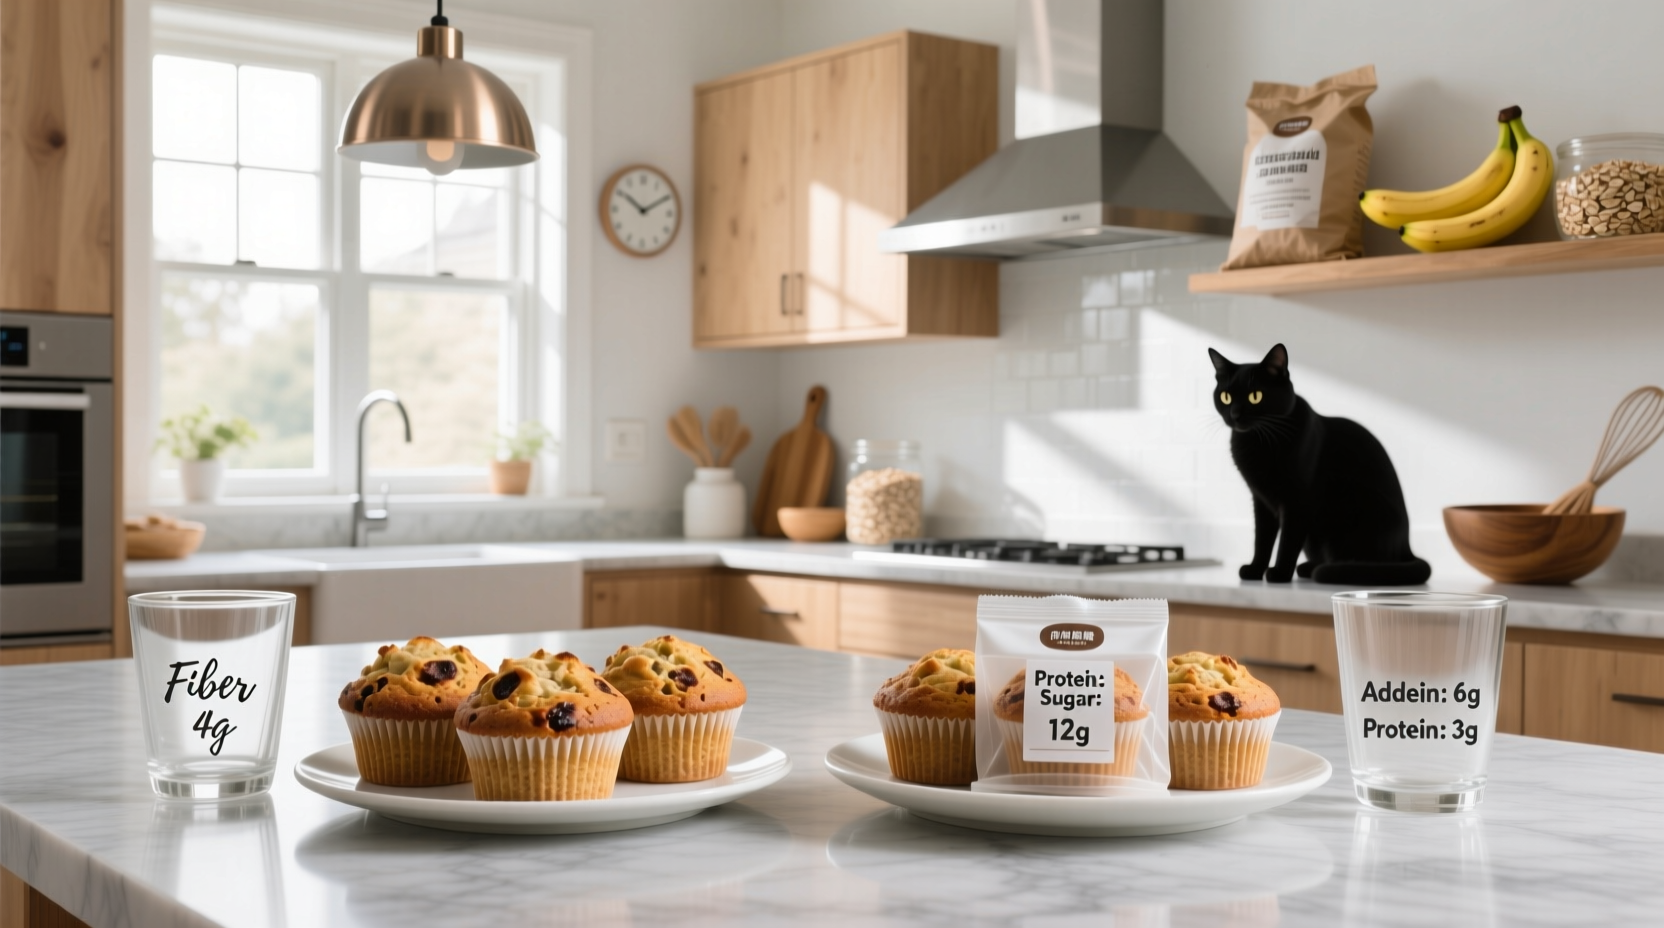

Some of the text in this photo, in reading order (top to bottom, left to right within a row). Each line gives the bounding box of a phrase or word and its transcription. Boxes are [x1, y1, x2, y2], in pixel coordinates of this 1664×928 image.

[164, 658, 257, 704] Fiber
[1034, 669, 1105, 688] Protein:
[1040, 688, 1102, 711] Sugar:
[1361, 680, 1481, 709] Addein: 6g
[193, 710, 237, 756] 4g
[1048, 718, 1090, 747] 12g
[1363, 717, 1478, 745] Protein: 3g
